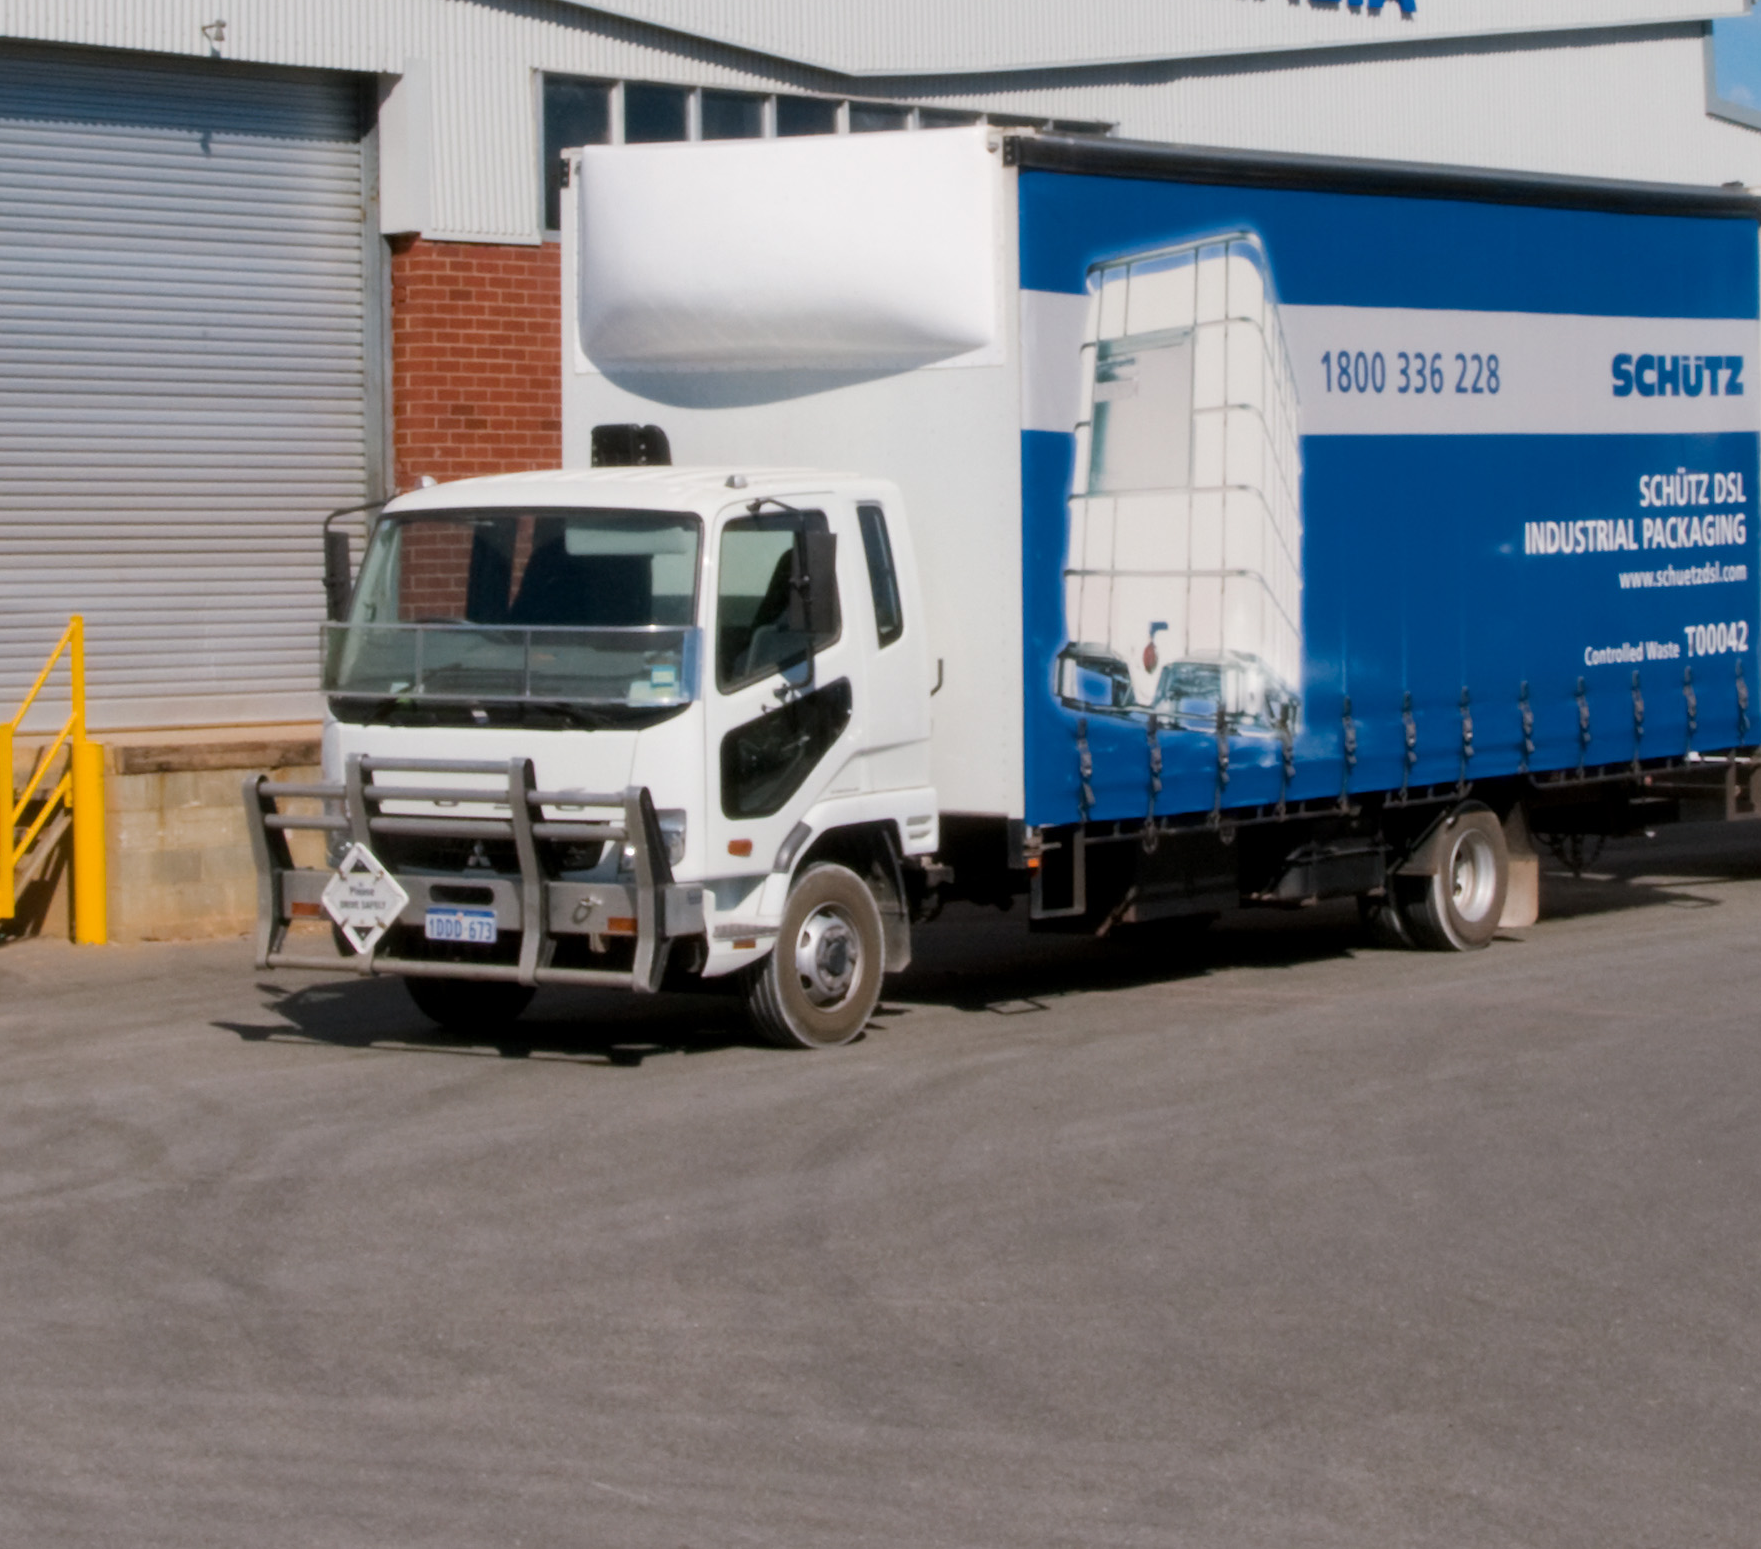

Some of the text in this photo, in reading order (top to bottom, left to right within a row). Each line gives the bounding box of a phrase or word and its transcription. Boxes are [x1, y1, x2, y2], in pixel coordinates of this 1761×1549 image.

[1321, 350, 1501, 395] 1800 336 228
[1611, 353, 1745, 398] SCHÜTZ
[1639, 467, 1747, 508] SCHÜTZ DSL
[1524, 513, 1747, 556] INDUSTRIAL PACKAGING
[1619, 560, 1748, 590] www.schuetzdsl.com
[1584, 620, 1749, 667] Controlled Waste T00042
